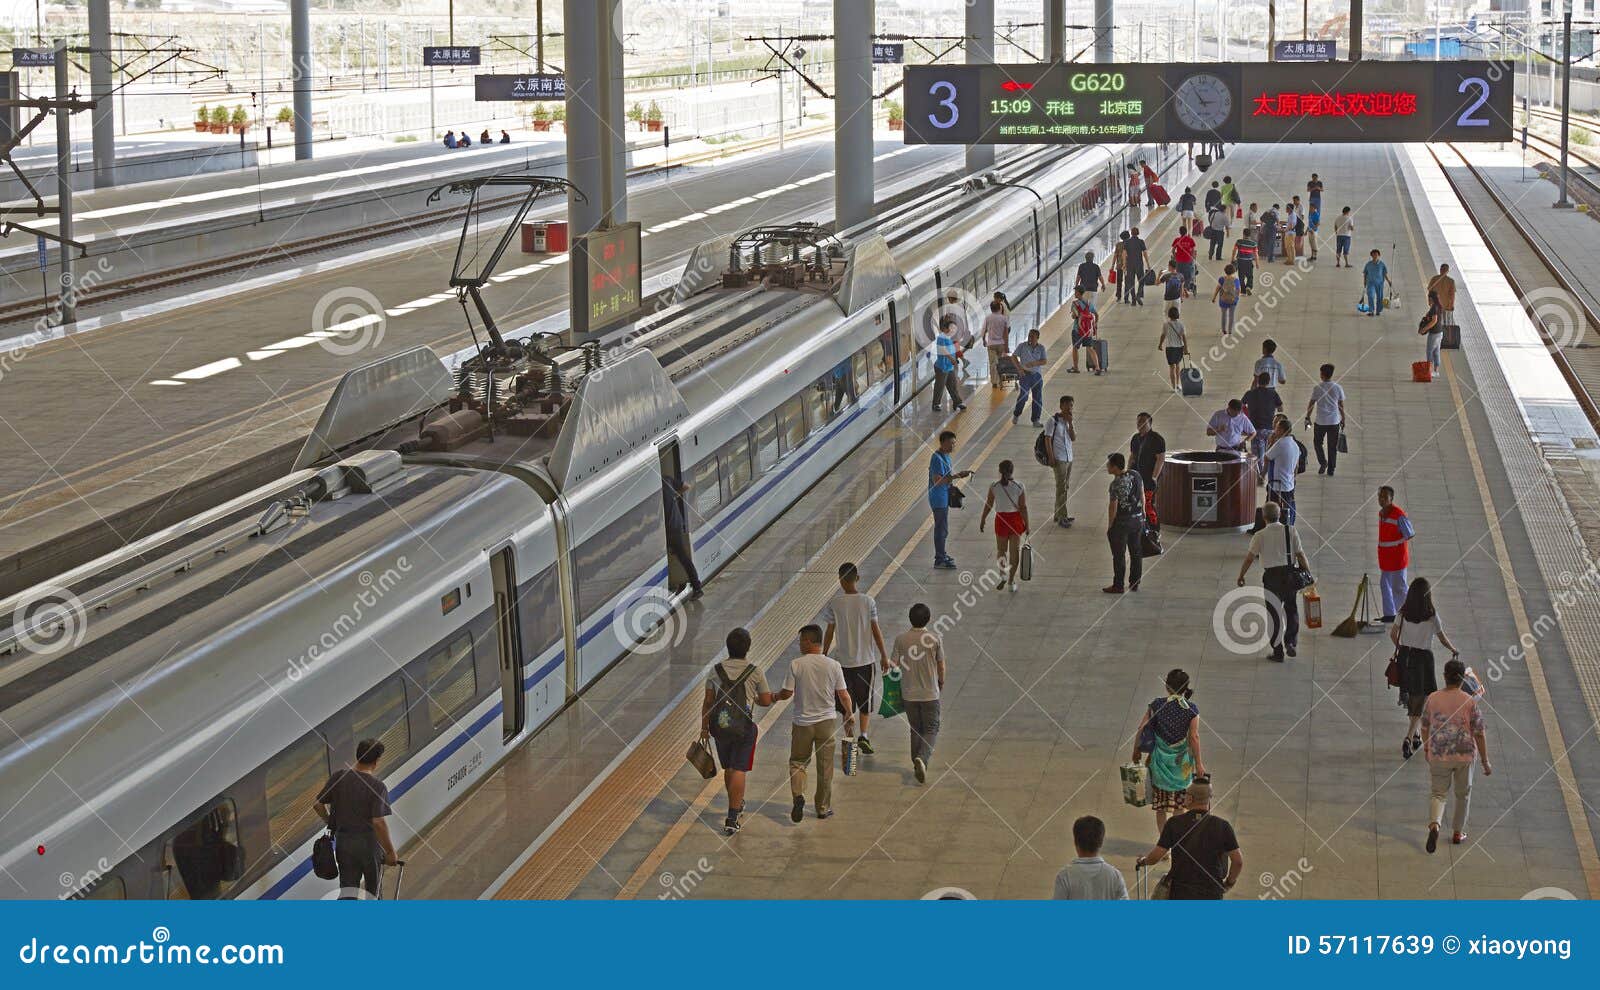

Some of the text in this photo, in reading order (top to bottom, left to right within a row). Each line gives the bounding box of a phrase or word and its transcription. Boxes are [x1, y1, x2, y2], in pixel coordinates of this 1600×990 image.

[1284, 43, 1326, 54] 太原南站
[1071, 73, 1125, 91] G620
[928, 80, 959, 128] 3
[991, 100, 1143, 115] 15:09 开往 北京西
[1253, 91, 1417, 117] 太原南站欢迎您
[1456, 77, 1490, 126] 2
[849, 742, 858, 776] SAMSUNG
